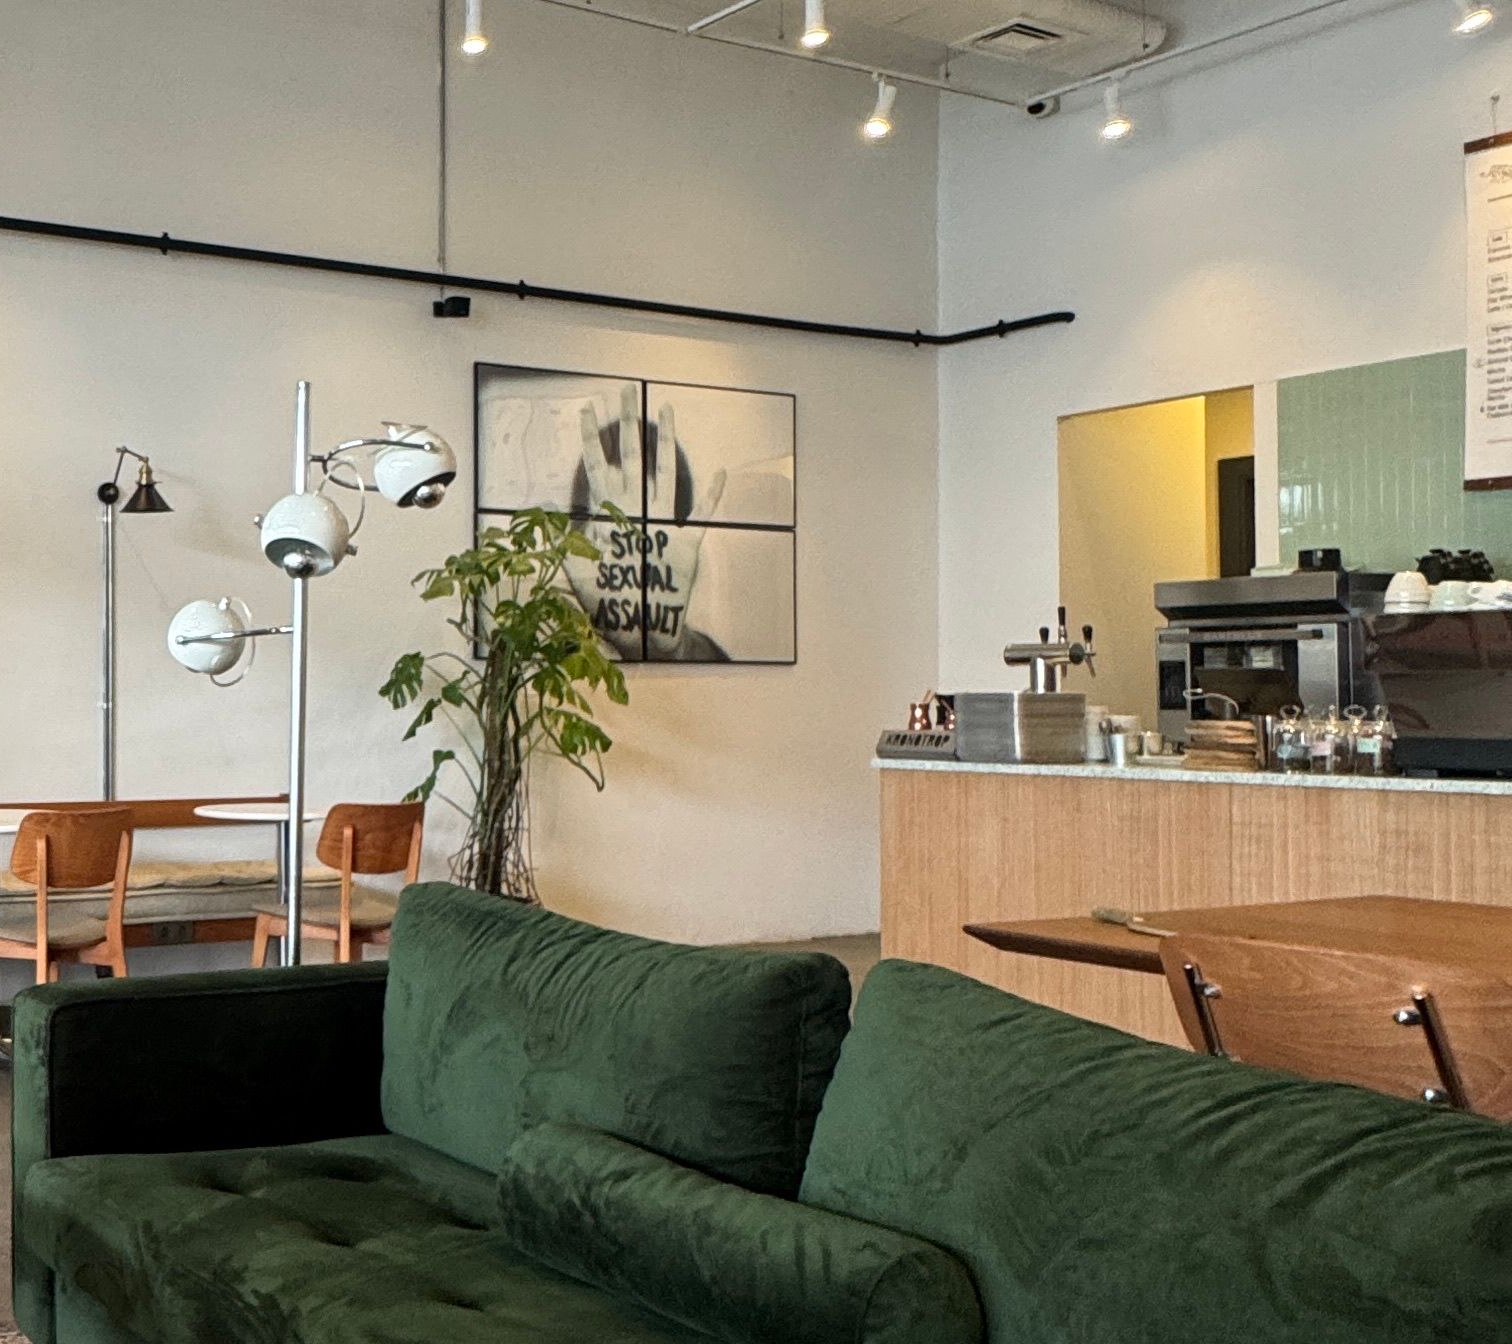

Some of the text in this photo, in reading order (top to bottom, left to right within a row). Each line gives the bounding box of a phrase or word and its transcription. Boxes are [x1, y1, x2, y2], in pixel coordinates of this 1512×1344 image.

[610, 530, 668, 560] STOP
[596, 562, 679, 593] SEXUAL
[593, 598, 684, 638] ASSAULT
